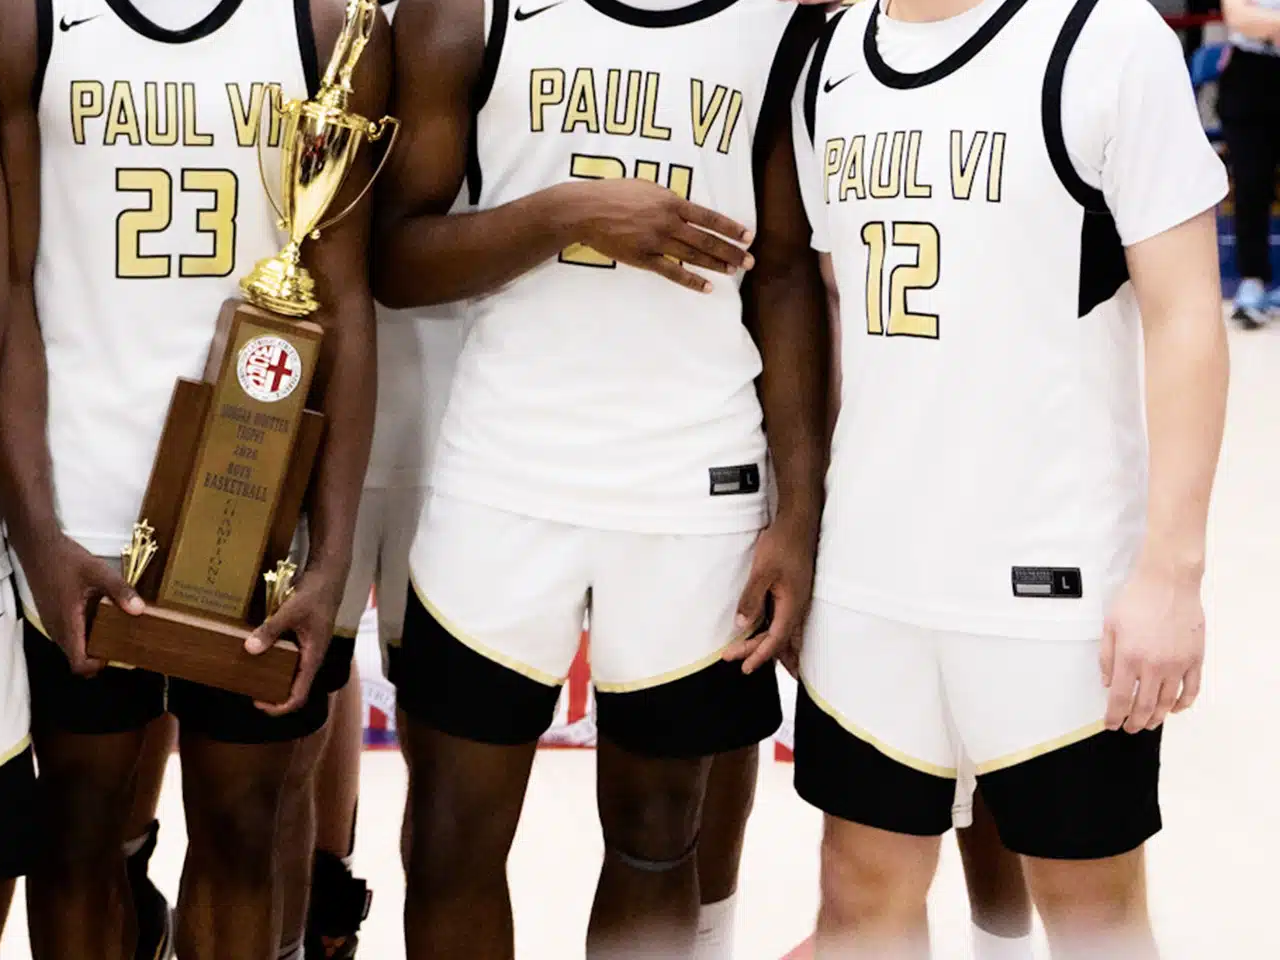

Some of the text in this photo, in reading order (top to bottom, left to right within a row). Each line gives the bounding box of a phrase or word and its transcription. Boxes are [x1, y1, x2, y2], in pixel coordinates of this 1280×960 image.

[71, 80, 281, 147] PAUL VI
[529, 68, 743, 155] PAUL VI
[823, 129, 1007, 204] PAUL VI
[115, 167, 239, 279] 23
[860, 221, 941, 340] 12
[204, 472, 268, 502] BASKETBALL
[1061, 575, 1071, 589] L
